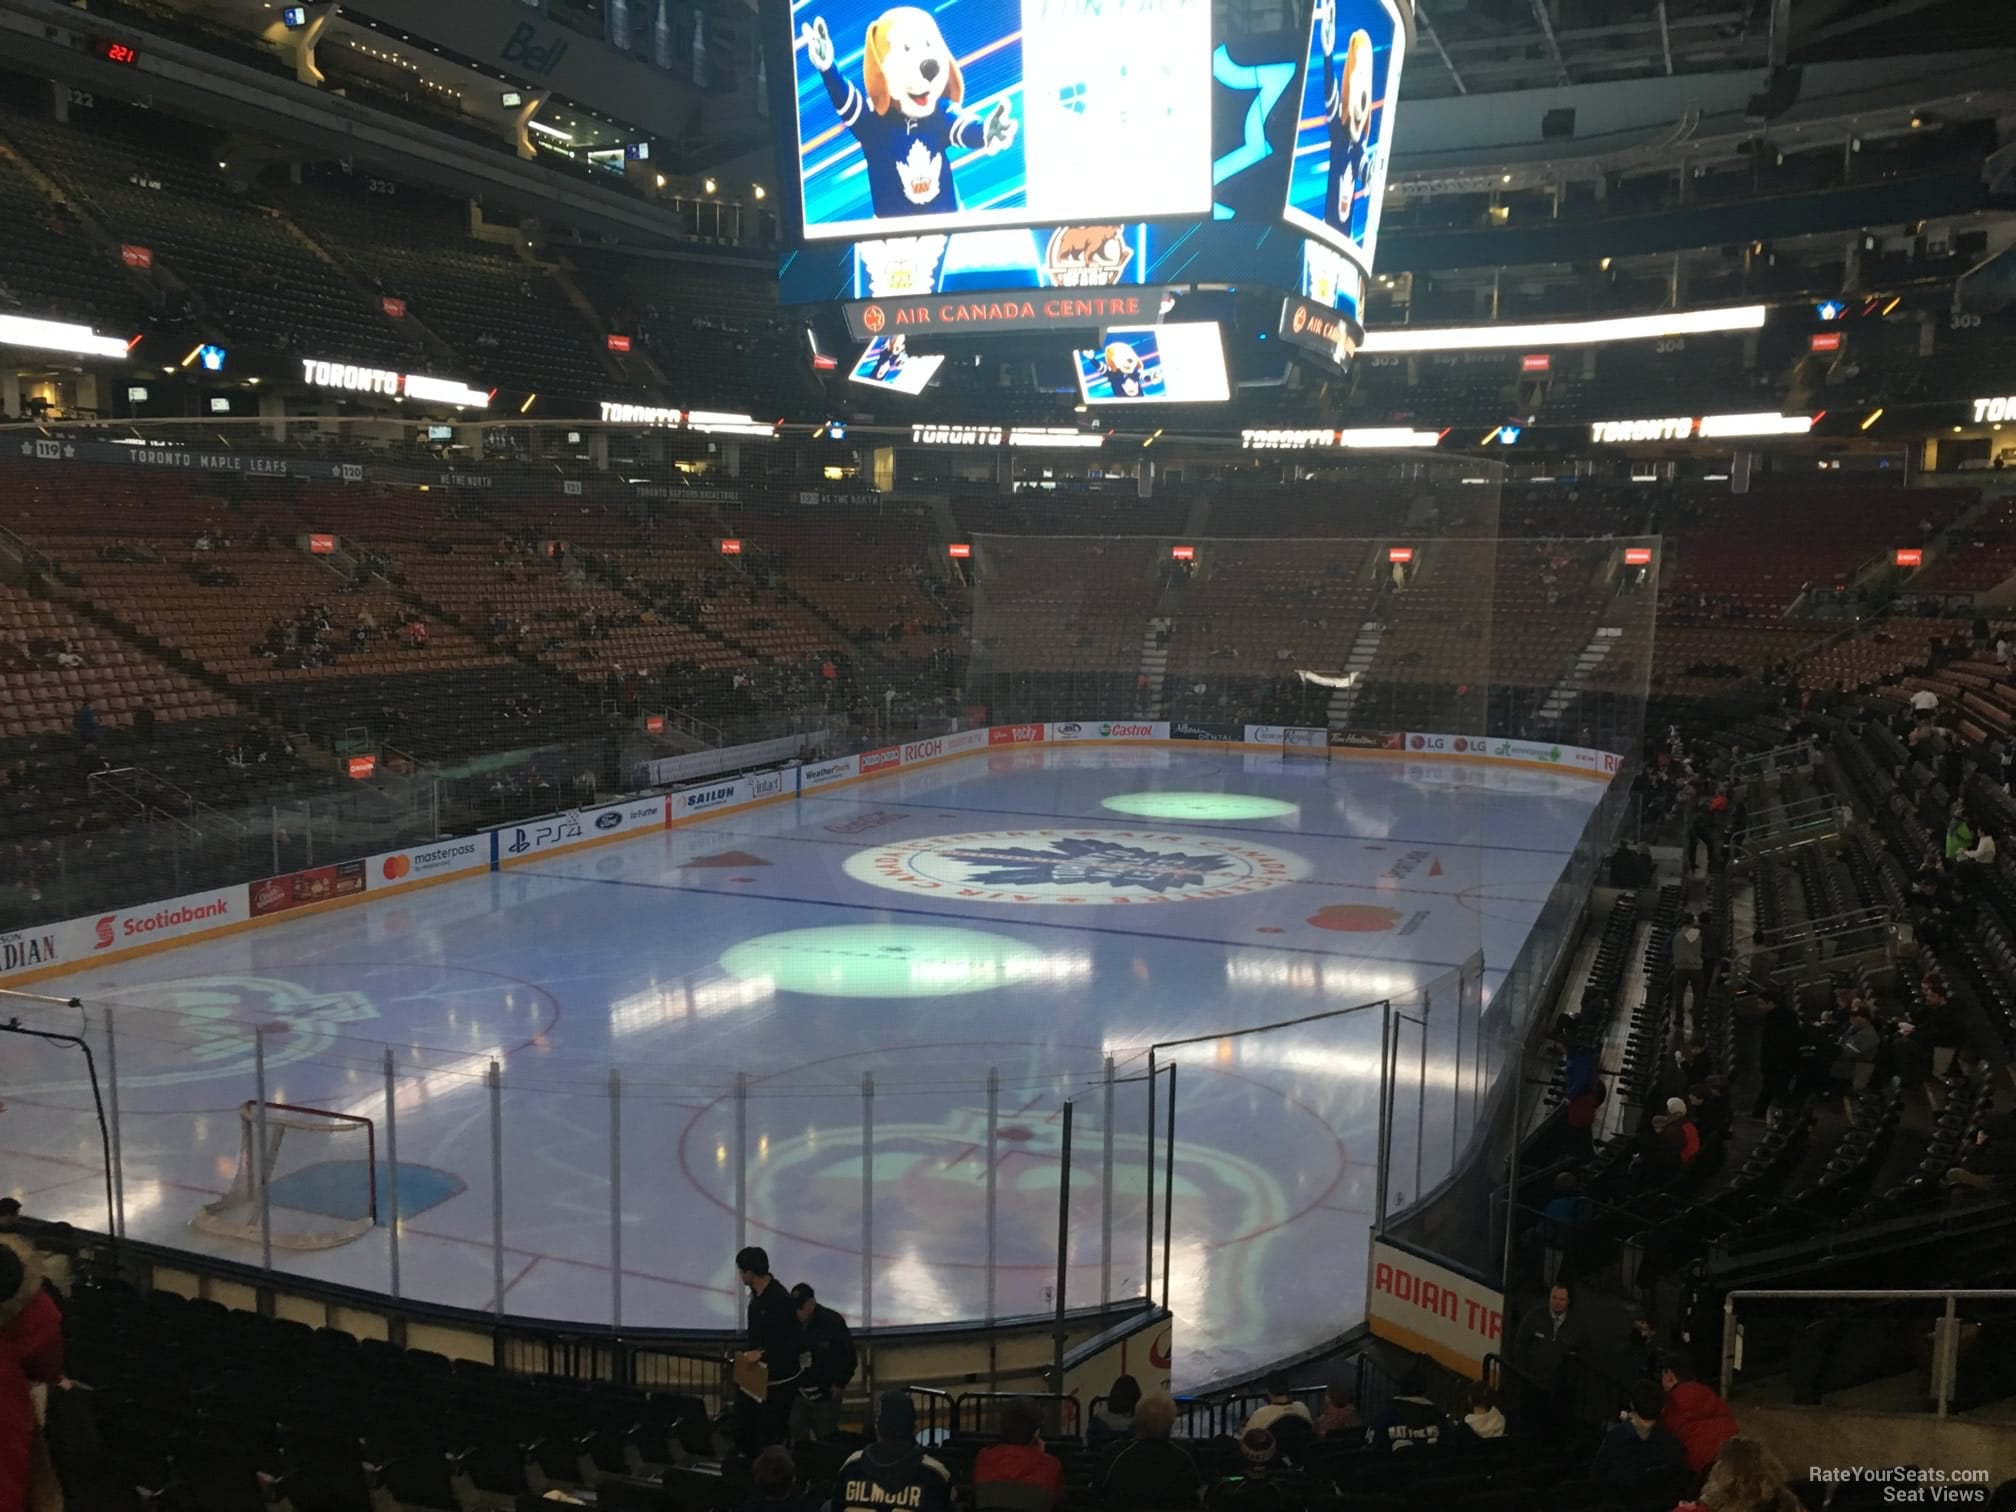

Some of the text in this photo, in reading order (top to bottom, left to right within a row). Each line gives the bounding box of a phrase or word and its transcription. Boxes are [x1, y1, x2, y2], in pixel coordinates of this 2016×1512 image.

[108, 43, 134, 63] 221
[502, 22, 568, 77] Bell
[369, 178, 395, 195] 323
[896, 297, 1139, 325] AIR CANADA CENTRE
[1306, 315, 1324, 335] AIR
[302, 358, 398, 395] TORONTO
[912, 424, 1002, 445] TORONTO
[1591, 417, 1692, 443] TORONTO
[38, 442, 59, 457] 119
[130, 449, 287, 472] TORONTO MAPLE LEAFS
[343, 466, 362, 478] 120
[451, 475, 464, 486] THE
[1112, 724, 1152, 737] Castrol
[906, 739, 942, 760] RICOH
[1427, 738, 1444, 749] LG
[1470, 740, 1486, 752] LG
[687, 787, 735, 806] SAILUN
[536, 823, 583, 846] PS4
[414, 844, 476, 864] masterpass
[124, 898, 227, 937] Scotiabank
[1376, 1262, 1458, 1323] ADIAN
[845, 1480, 922, 1507] GILMOUR
